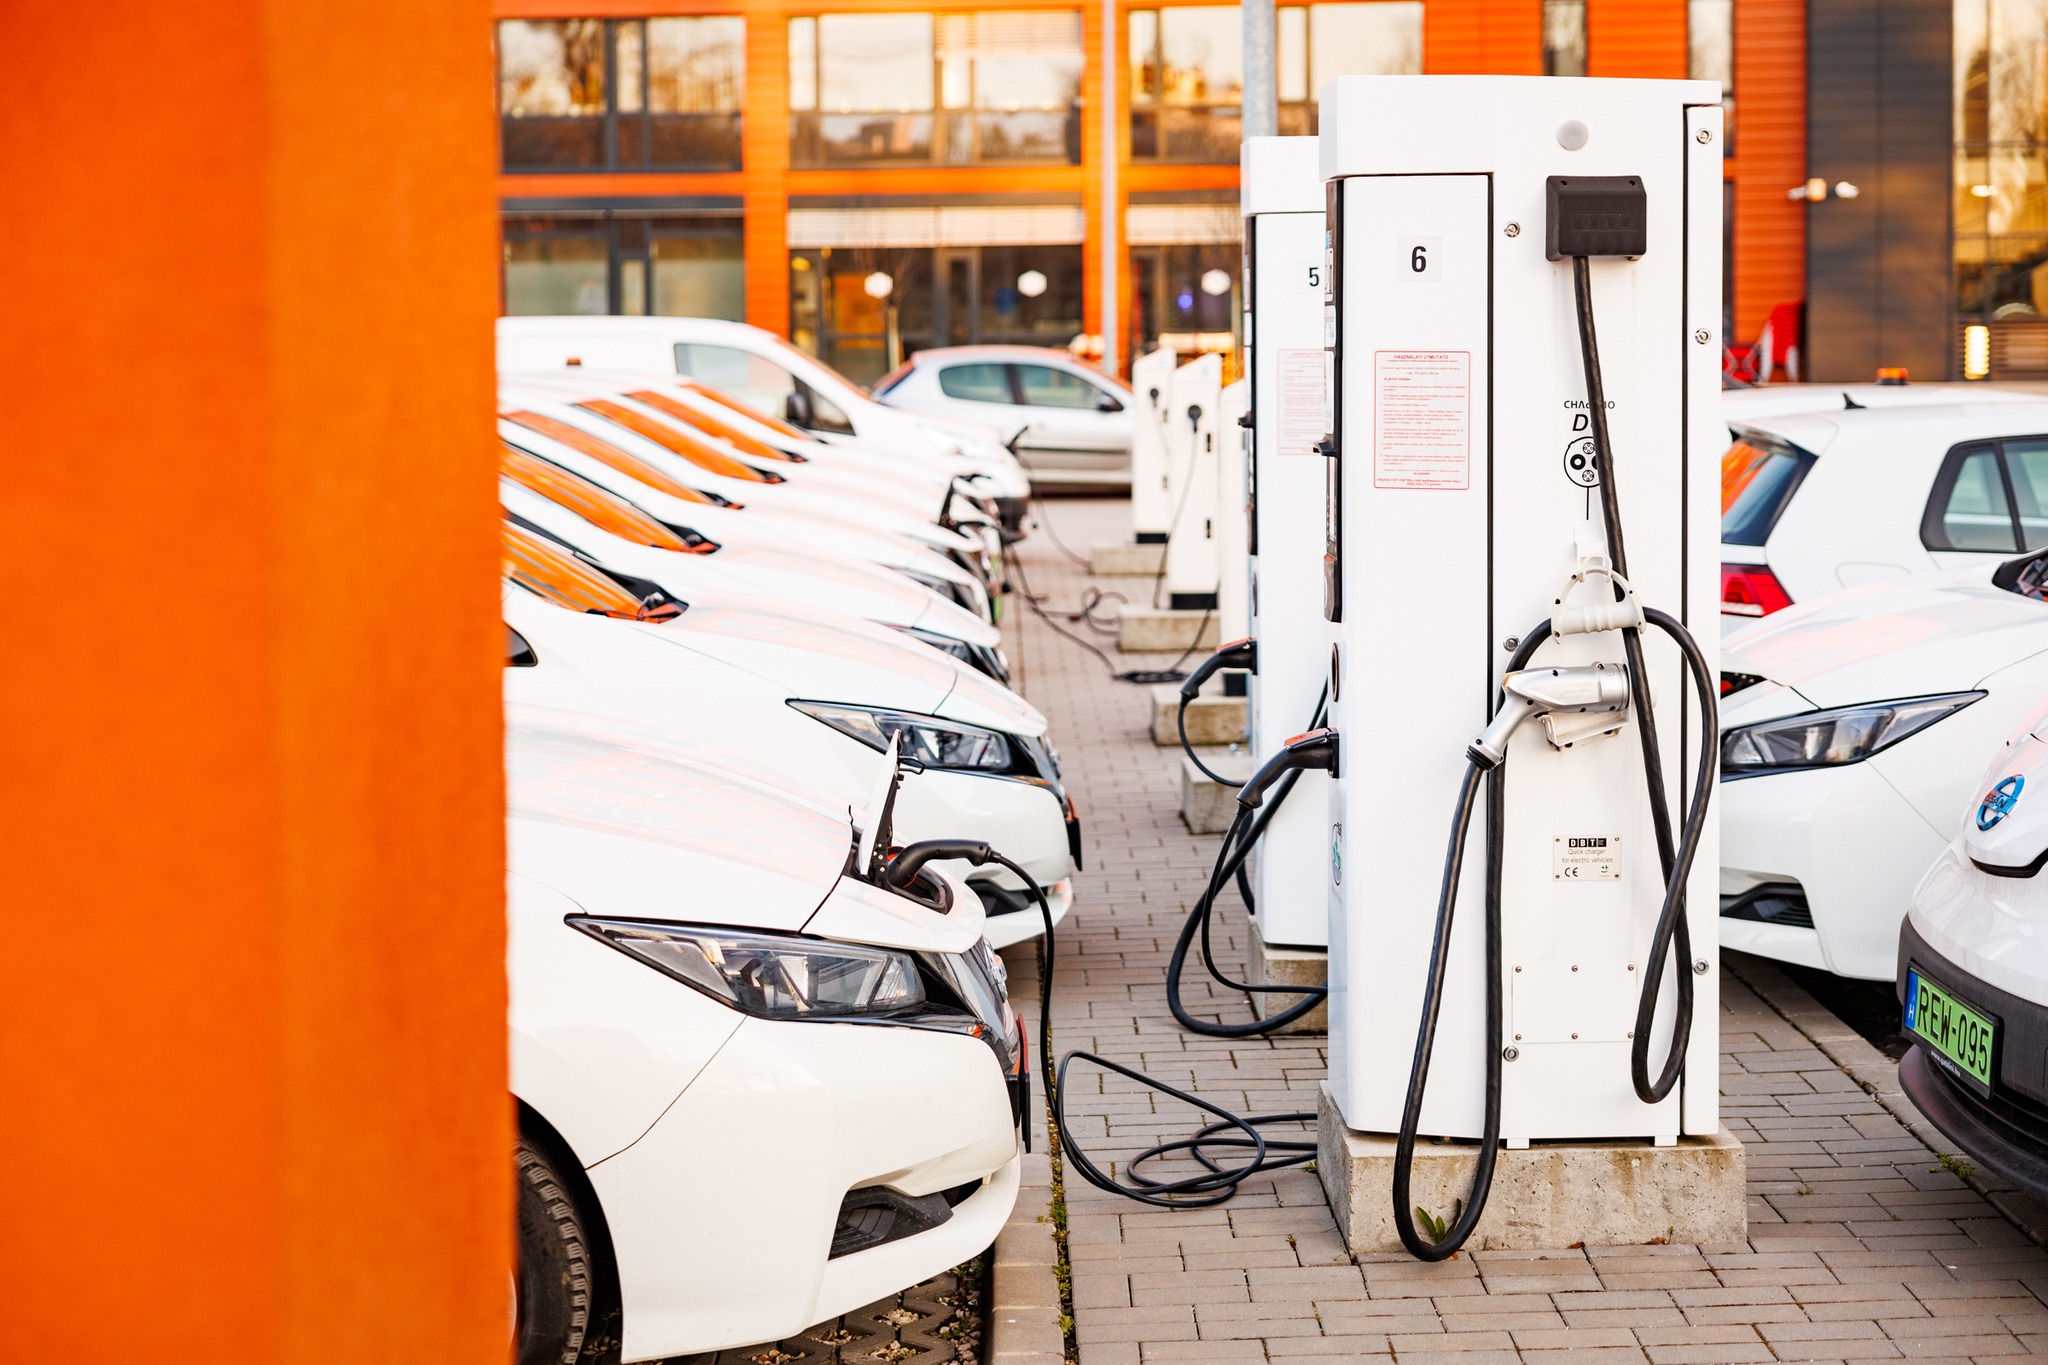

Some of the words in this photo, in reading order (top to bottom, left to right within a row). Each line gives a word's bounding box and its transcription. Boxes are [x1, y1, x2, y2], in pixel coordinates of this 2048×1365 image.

[1411, 246, 1427, 272] 6
[1308, 267, 1320, 287] 5
[1563, 400, 1616, 409] CHAO
[1572, 413, 1592, 431] D
[1569, 838, 1597, 847] DBT
[1908, 1003, 1915, 1021] H
[1918, 983, 1990, 1076] REW-095
